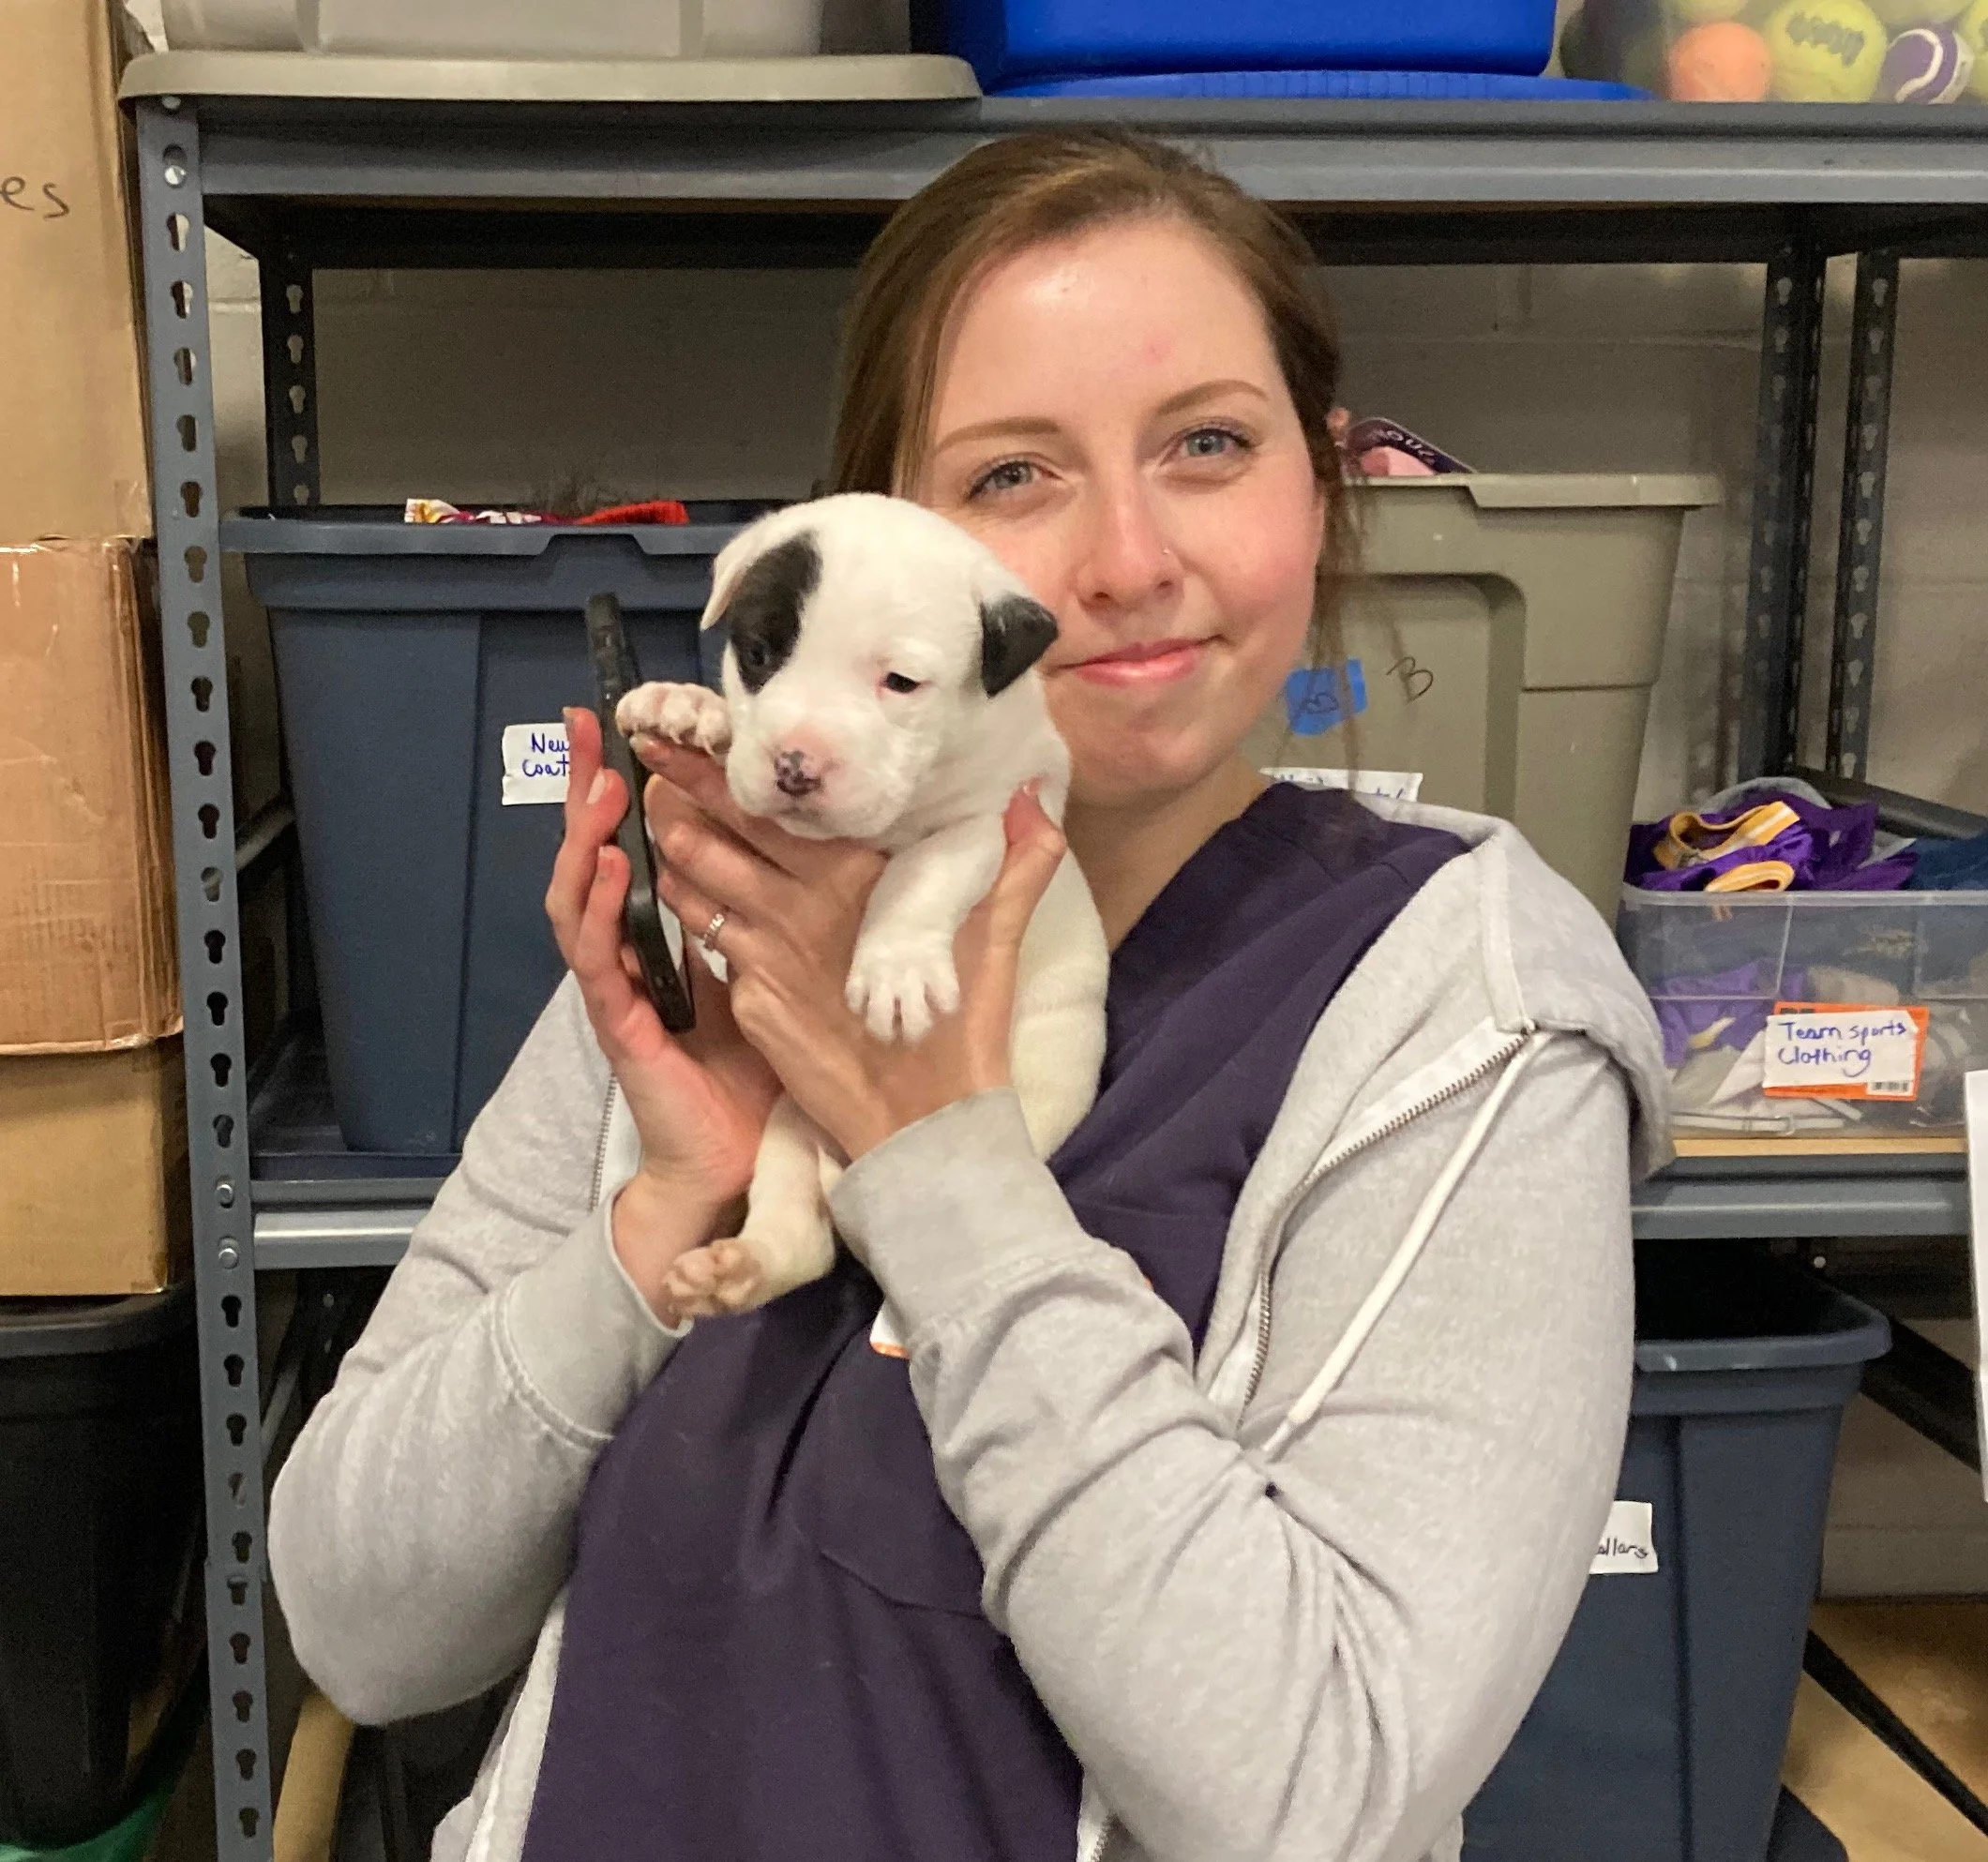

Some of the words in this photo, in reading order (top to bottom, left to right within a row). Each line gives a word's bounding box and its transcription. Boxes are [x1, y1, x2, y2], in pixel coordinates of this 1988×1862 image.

[1778, 1021, 1843, 1041] Team
[1849, 1019, 1906, 1046] sports
[1778, 1045, 1872, 1078] Clothing
[1594, 1537, 1649, 1559] ollars
